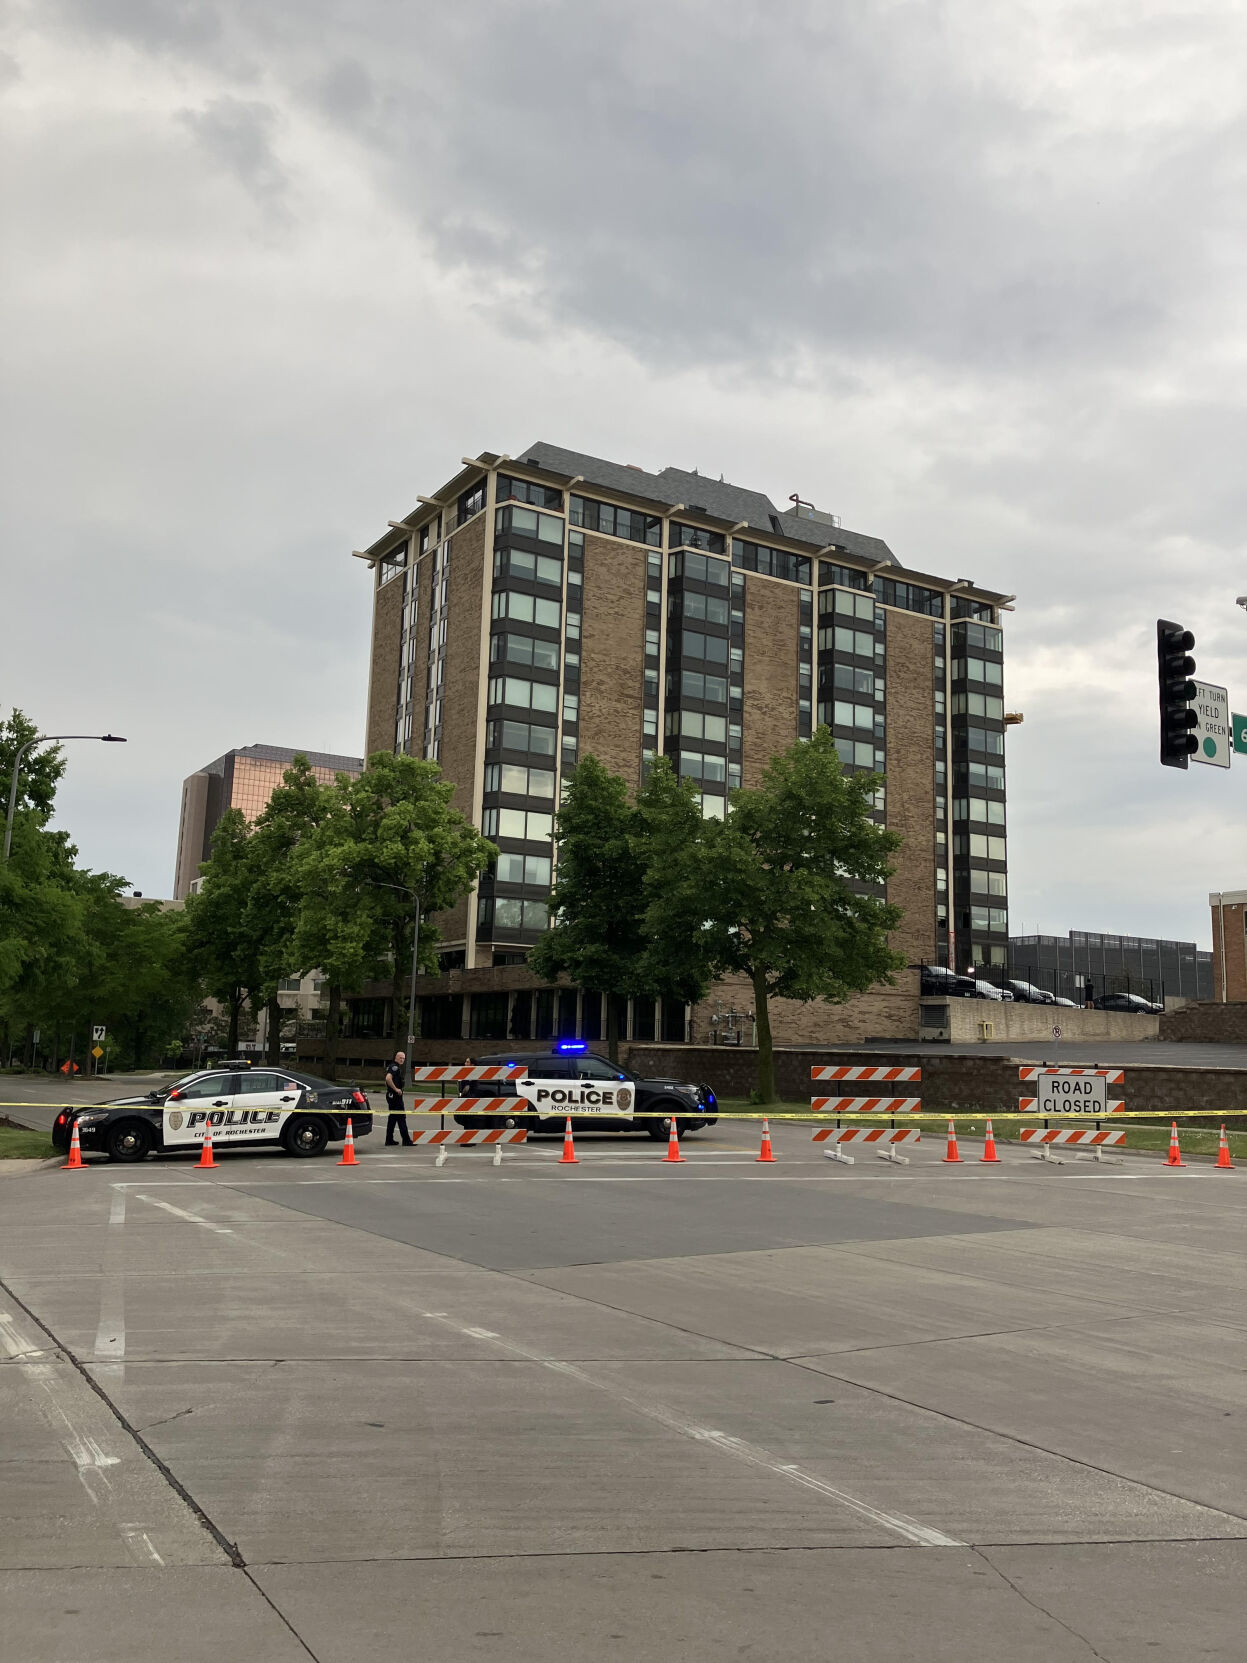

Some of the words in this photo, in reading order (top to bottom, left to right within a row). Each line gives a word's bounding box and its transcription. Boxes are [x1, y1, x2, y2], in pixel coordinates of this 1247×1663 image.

[1209, 690, 1226, 703] TURN
[1198, 704, 1220, 719] YIELD
[1205, 722, 1226, 735] GREEN
[1051, 1080, 1093, 1095] ROAD
[537, 1088, 614, 1106] POLICE
[551, 1105, 602, 1113] ROCHESTER
[1043, 1099, 1101, 1113] CLOSED
[186, 1109, 281, 1129] POLICE
[225, 1128, 266, 1136] ROCHESTER
